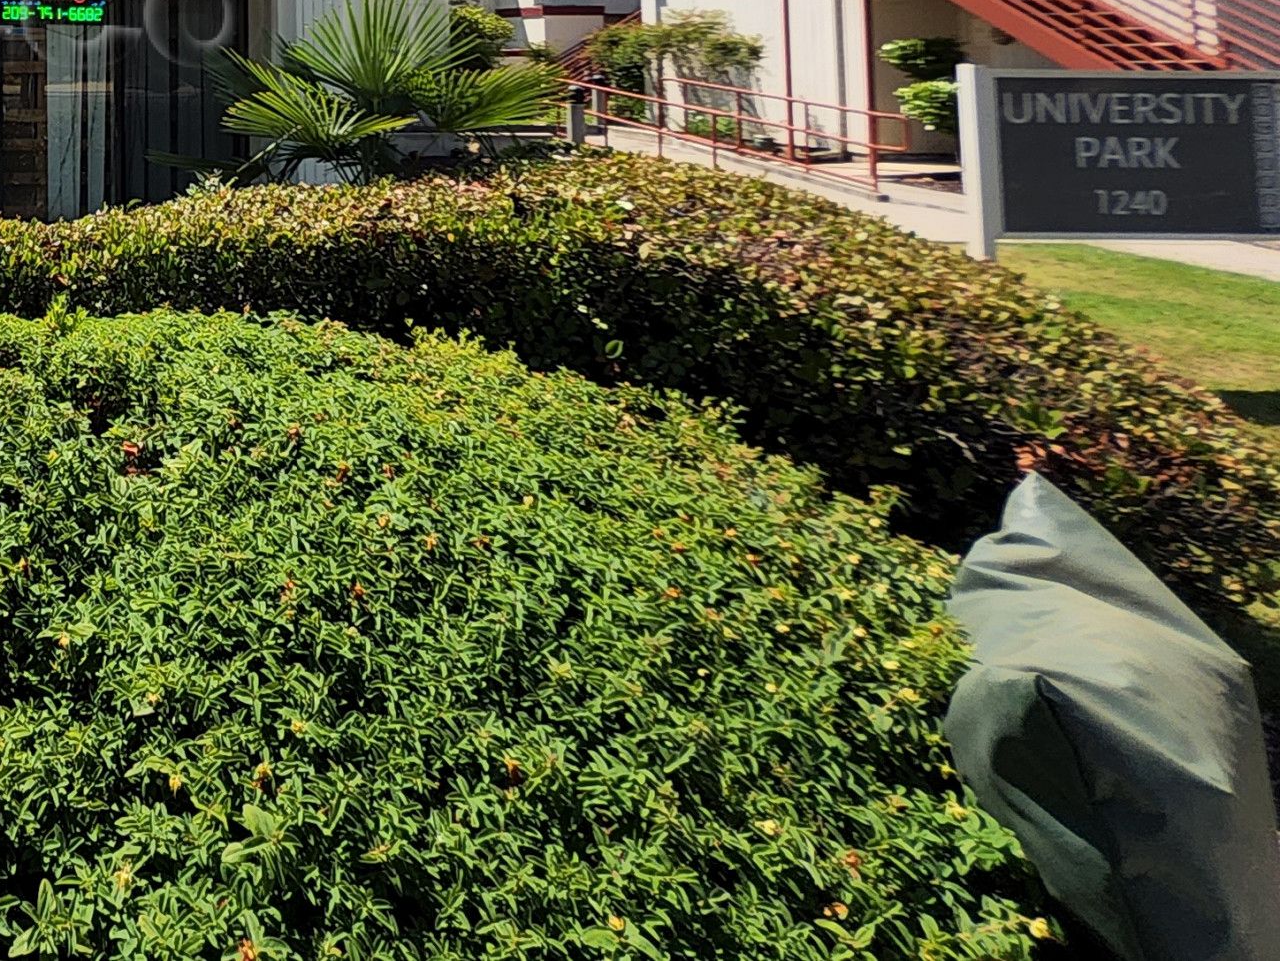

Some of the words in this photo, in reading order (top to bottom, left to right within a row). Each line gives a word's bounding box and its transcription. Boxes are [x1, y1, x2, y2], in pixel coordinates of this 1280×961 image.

[1002, 92, 1249, 125] UNIVERSITY
[1074, 136, 1182, 169] PARK
[1094, 189, 1169, 216] 1240
